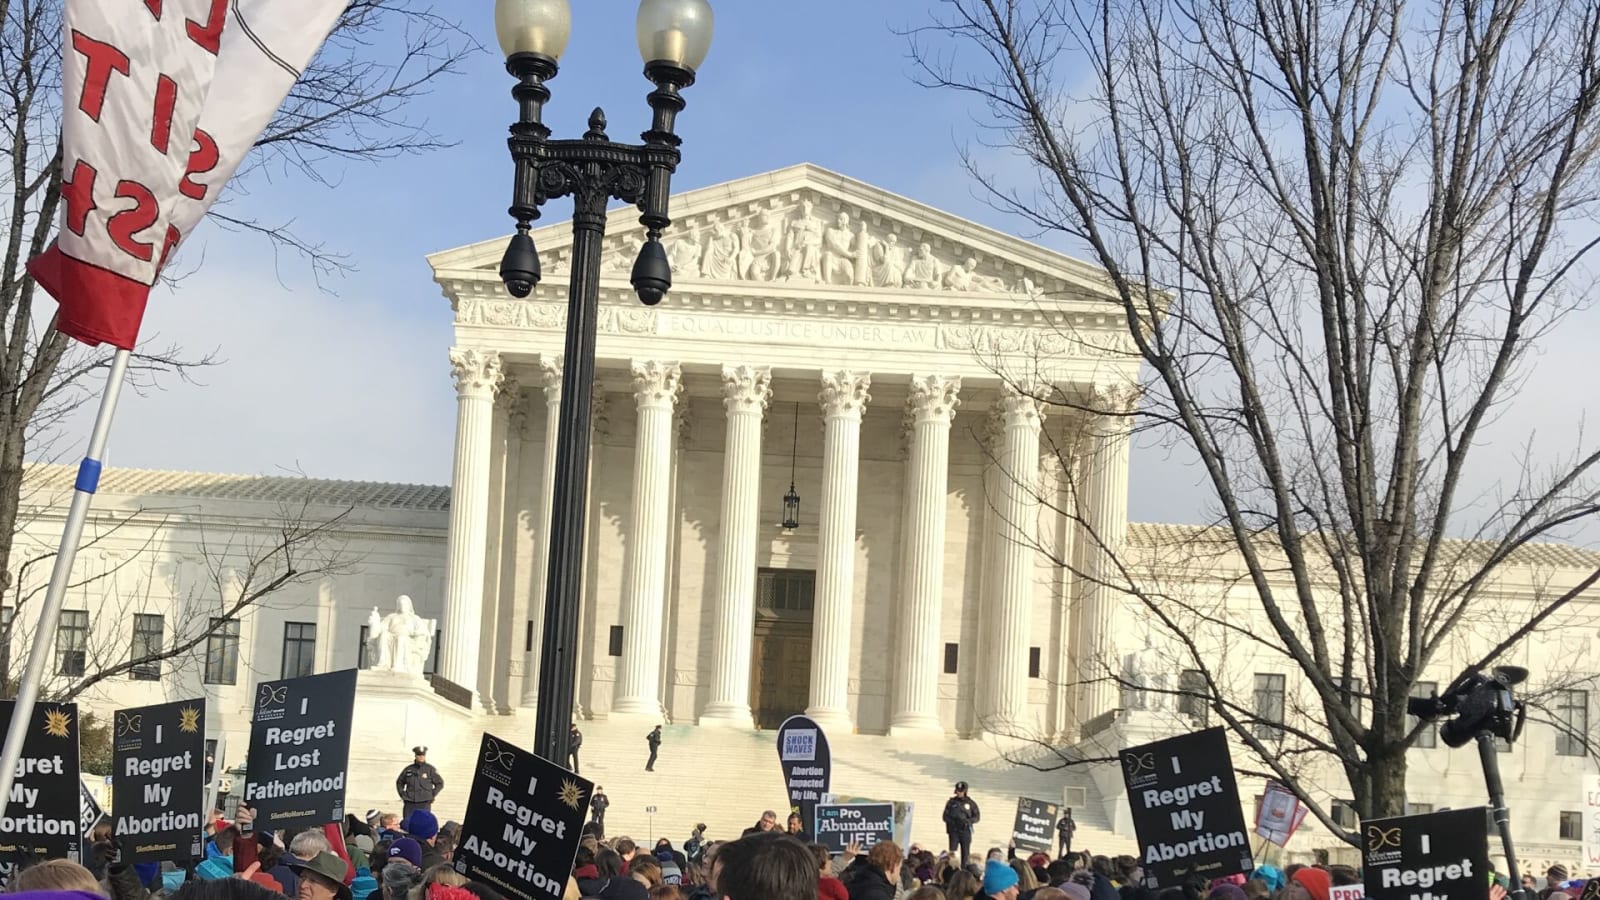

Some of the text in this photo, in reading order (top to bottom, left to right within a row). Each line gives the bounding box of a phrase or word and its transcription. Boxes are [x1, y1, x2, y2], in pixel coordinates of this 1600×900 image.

[671, 316, 927, 344] EQUAL JUSTICE UNDER LAW
[300, 698, 308, 715] I
[156, 725, 162, 744] I
[265, 720, 335, 745] Regret
[786, 735, 813, 745] SHOCK
[275, 749, 320, 770] Lost
[785, 744, 813, 754] WAVES
[14, 755, 63, 777] gret
[126, 750, 192, 778] Regret
[791, 766, 824, 776] Abortion
[1171, 756, 1181, 774] I
[246, 772, 344, 800] Fatherhood
[528, 776, 538, 796] I
[789, 778, 824, 788] Impacted
[1143, 775, 1223, 808] Regret
[8, 783, 39, 808] My
[144, 783, 172, 807] My
[791, 790, 803, 800] My
[803, 790, 819, 800] Life.
[115, 810, 199, 836] Abortion
[486, 785, 566, 840] Regret
[839, 808, 862, 818] Pro
[1170, 809, 1204, 831] My
[0, 813, 75, 835] ortion
[502, 823, 537, 856] My
[1145, 831, 1245, 865] Abortion
[1421, 834, 1430, 854] I
[463, 834, 561, 897] Abortion
[1381, 858, 1473, 888] Regret
